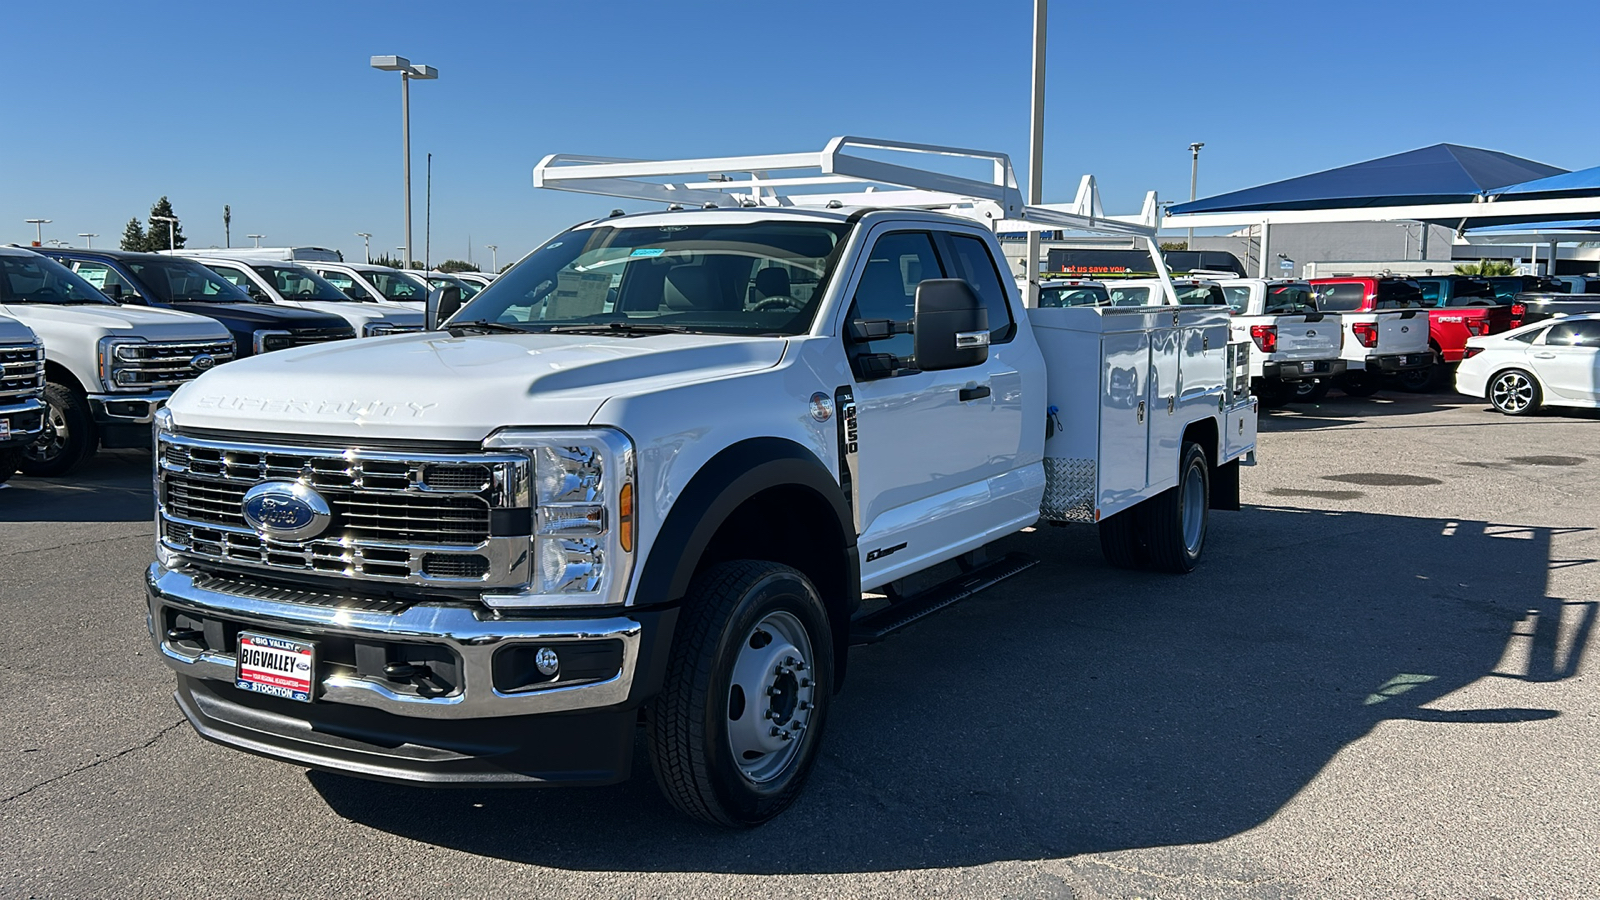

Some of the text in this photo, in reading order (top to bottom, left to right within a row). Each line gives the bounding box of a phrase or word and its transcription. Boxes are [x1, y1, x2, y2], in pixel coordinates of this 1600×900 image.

[198, 396, 439, 418] SUPER DUTY
[257, 497, 299, 525] Ford
[255, 637, 295, 650] BIG VALLEY
[242, 648, 297, 673] BIGVALLEY
[252, 683, 292, 697] STOCKTON
